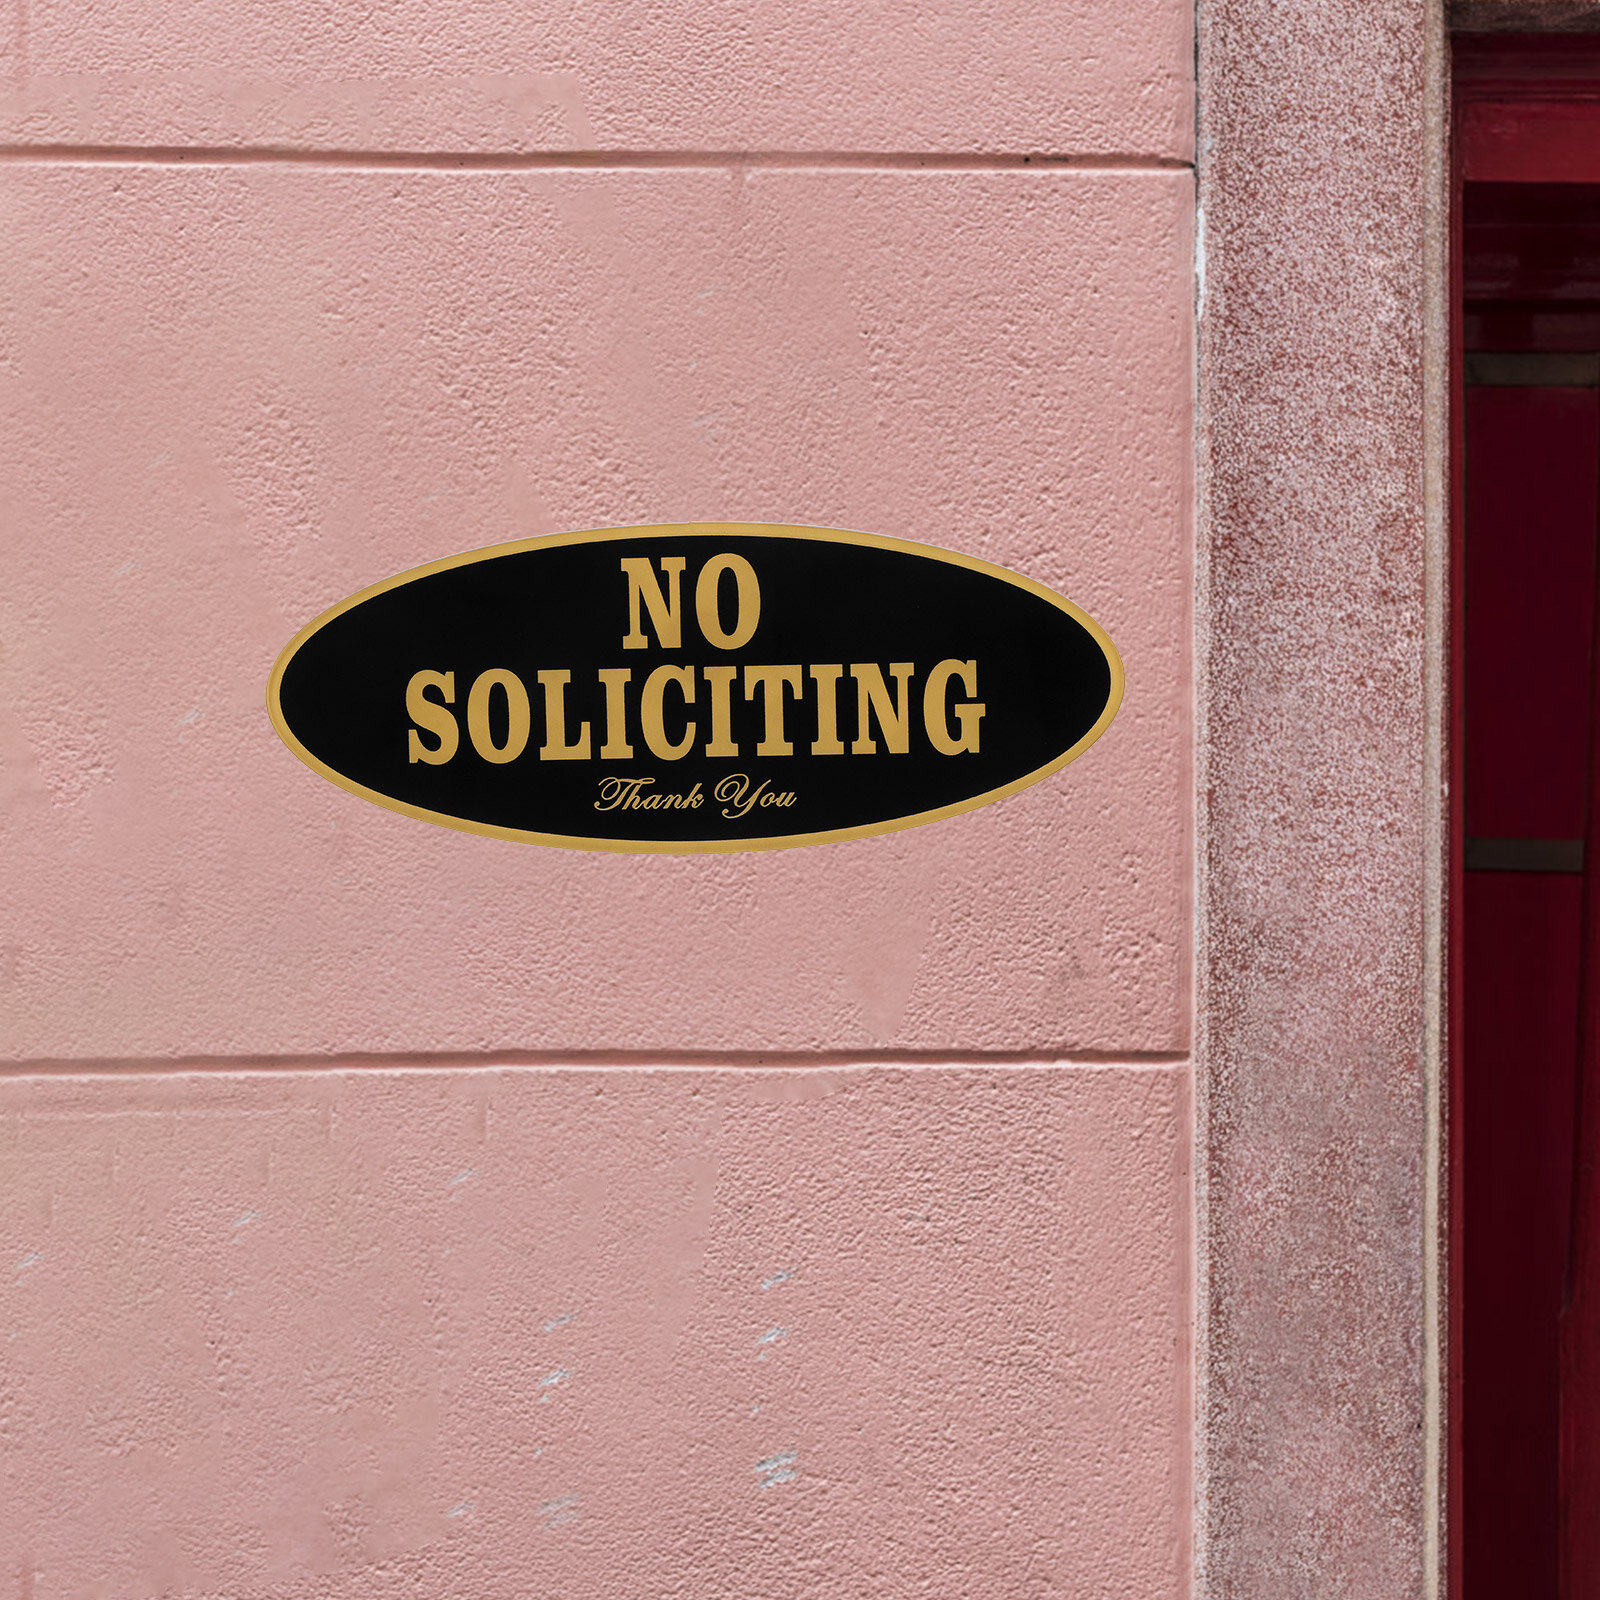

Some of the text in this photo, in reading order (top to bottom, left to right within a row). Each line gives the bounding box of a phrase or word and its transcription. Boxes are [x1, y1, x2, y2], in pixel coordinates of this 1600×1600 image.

[621, 553, 760, 649] NO
[406, 659, 985, 765] SOLICITING
[593, 773, 797, 819] Thank You
